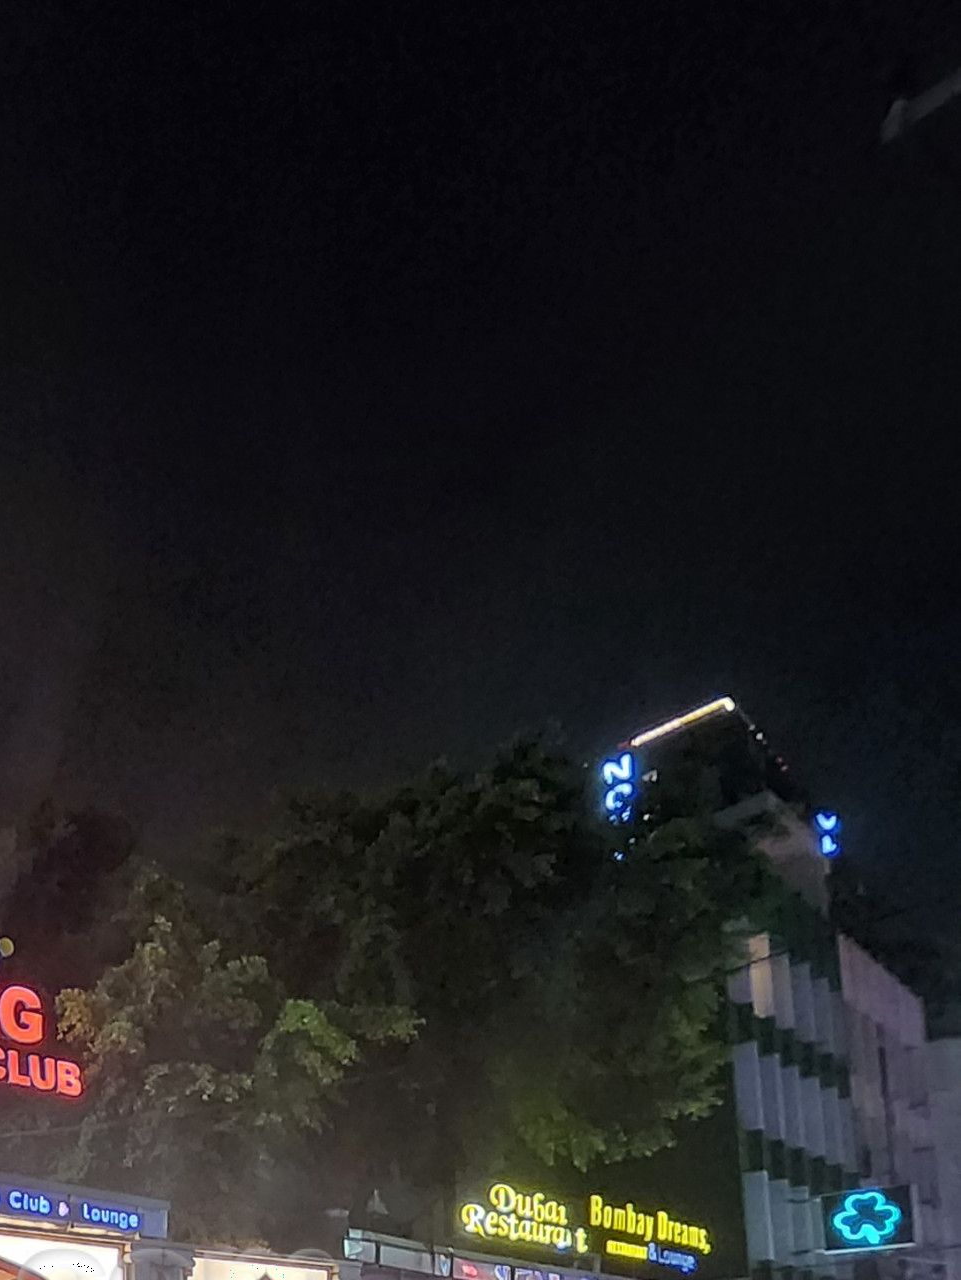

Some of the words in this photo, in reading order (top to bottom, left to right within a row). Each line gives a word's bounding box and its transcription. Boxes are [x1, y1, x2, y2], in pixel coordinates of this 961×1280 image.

[9, 1191, 50, 1214] Club
[83, 1203, 139, 1229] Lounge
[589, 1194, 654, 1242] Bombay
